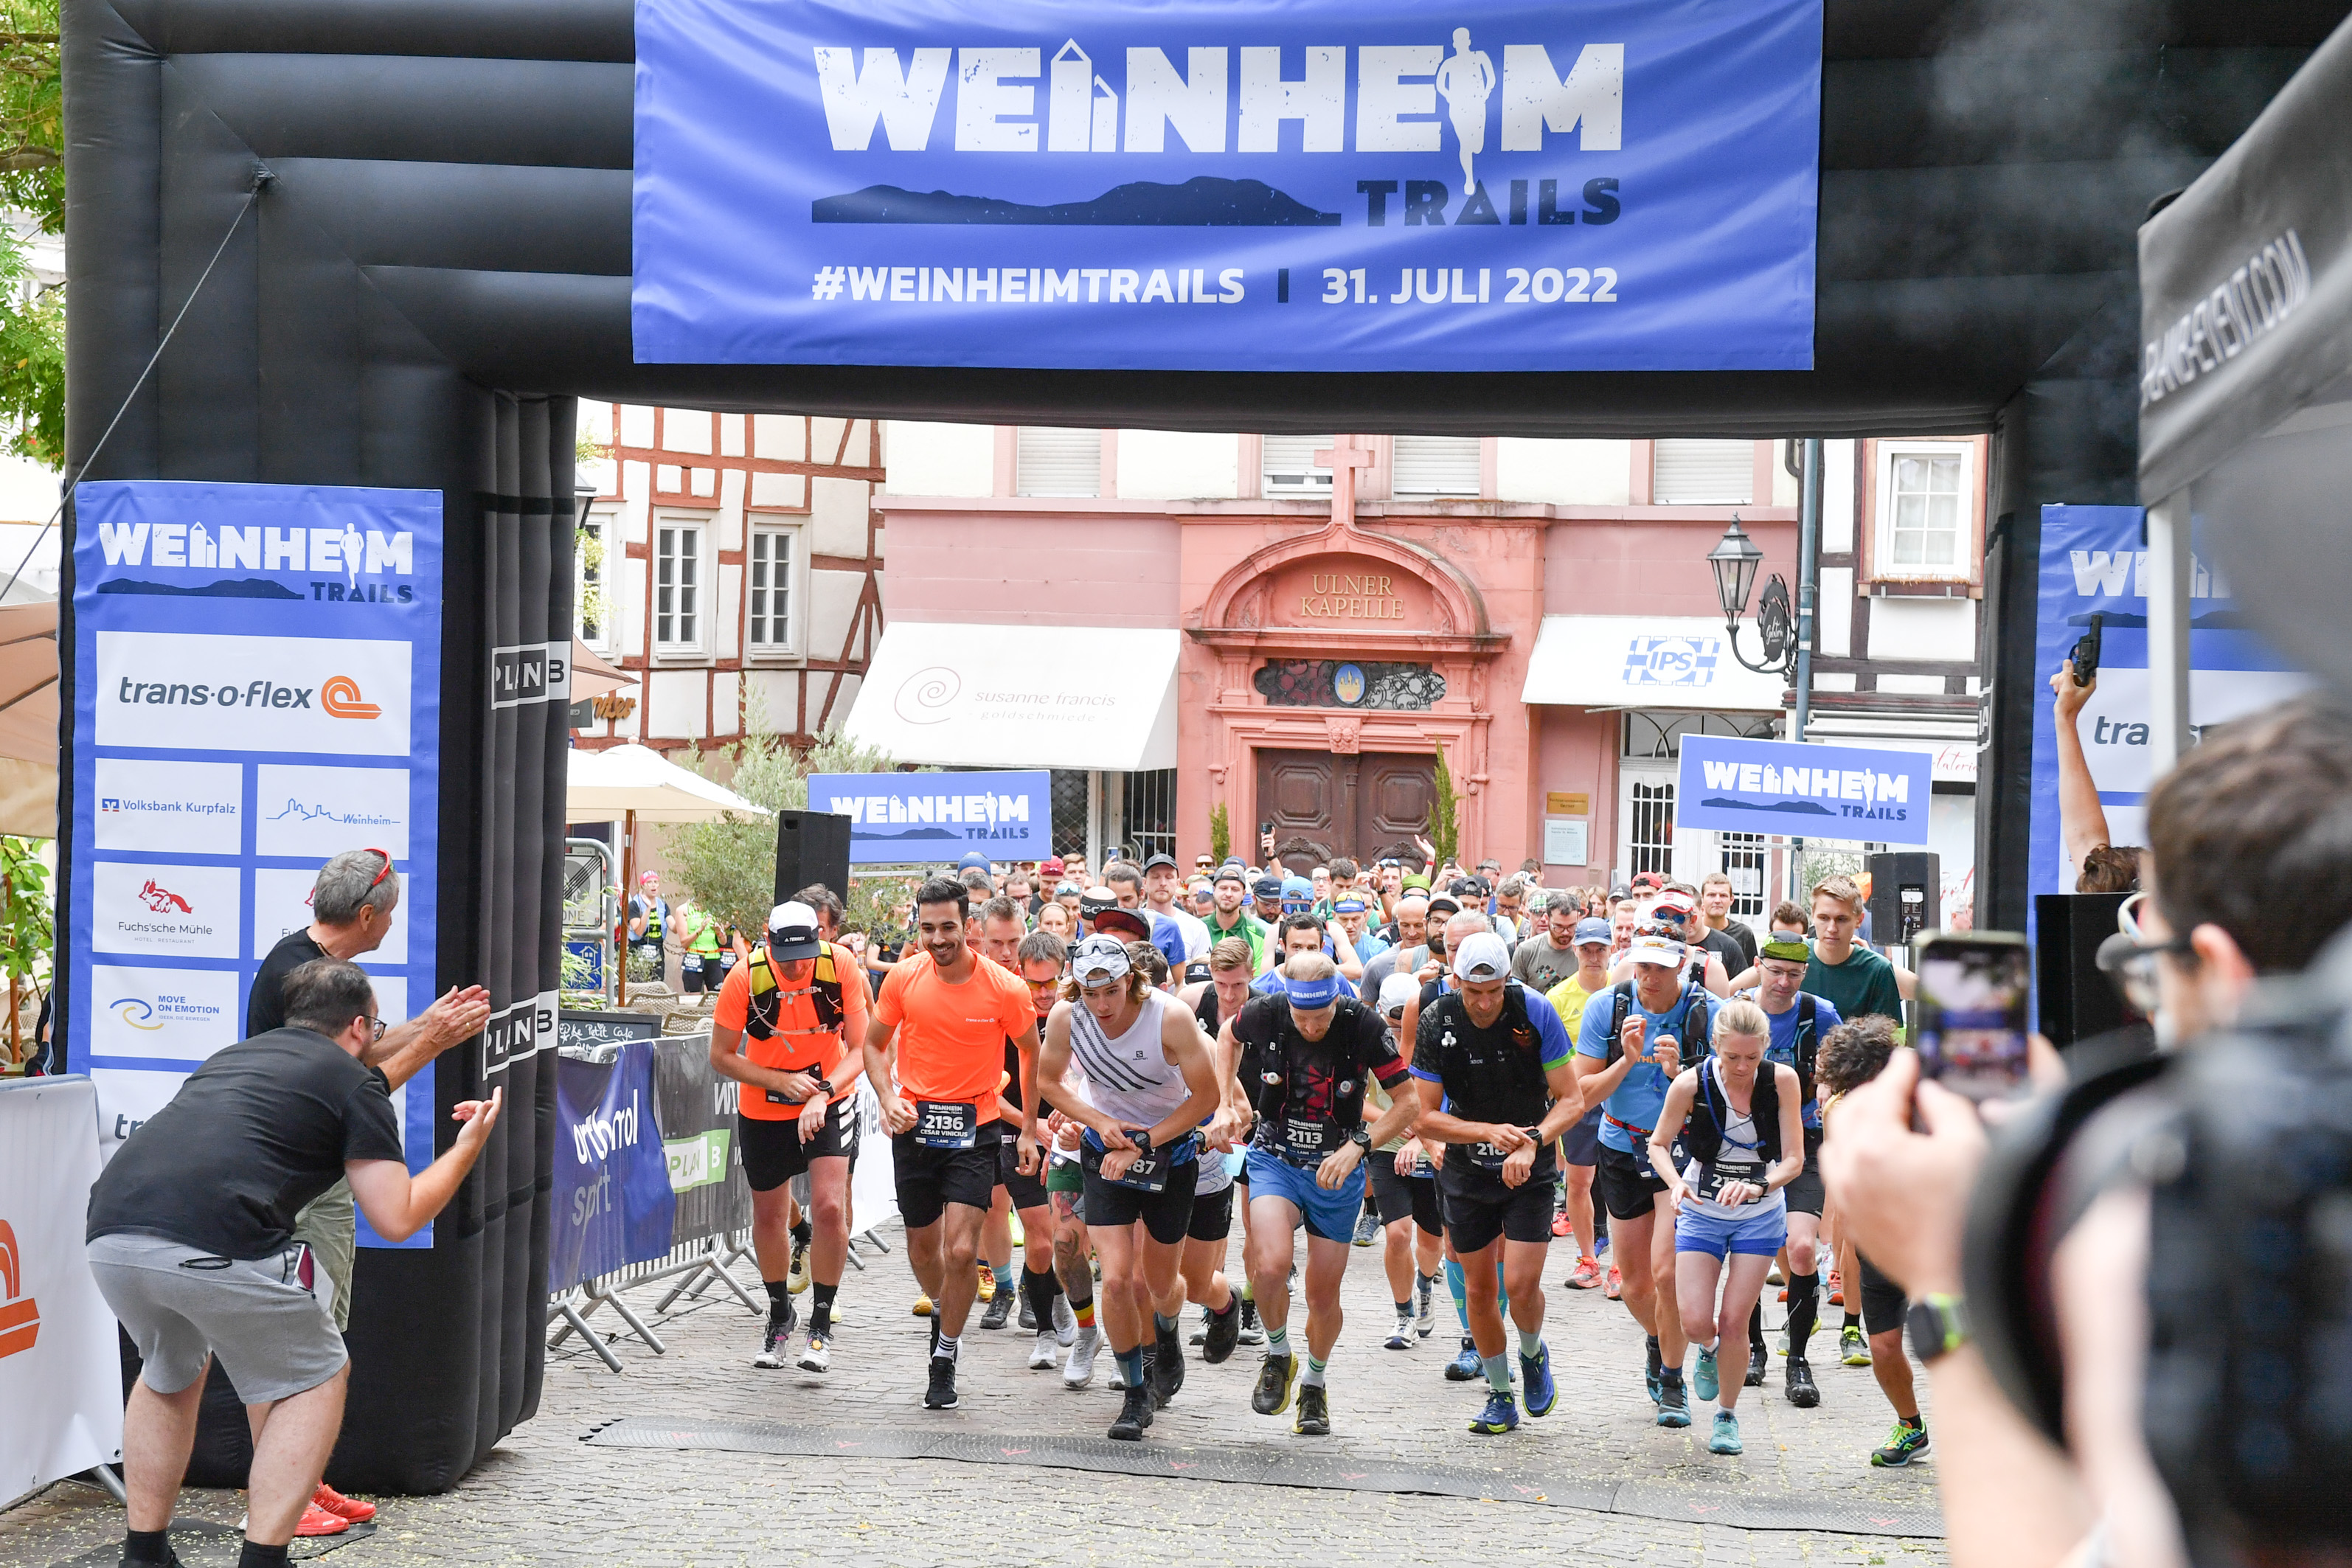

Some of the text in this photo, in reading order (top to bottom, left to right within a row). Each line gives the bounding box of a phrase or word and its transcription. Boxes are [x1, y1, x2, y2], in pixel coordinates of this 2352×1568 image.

[812, 33, 1625, 159] WEINHEIM
[1357, 177, 1621, 226] TRAILS
[812, 266, 1617, 304] #WEINHEIMTRAILS 31. JULI 2022
[99, 522, 413, 578] WEINHEIM
[311, 581, 413, 603] TRAILS
[1312, 575, 1393, 596] ULNER
[1300, 596, 1405, 619] KAPELLE
[1649, 651, 1693, 670] IPS
[975, 691, 1116, 707] susanne francis
[1703, 760, 1909, 804] WEINHEIM
[122, 799, 236, 815] Volksbank Kurpfalz
[830, 793, 1029, 825] WEINHEIM
[1841, 805, 1907, 822] TRAILS
[343, 814, 392, 825] Weinheim
[965, 828, 1029, 839] TRAILS
[562, 910, 585, 921] ONE
[119, 922, 212, 934] Fuchs'sche Mühle
[1291, 989, 1328, 999] WEINHEIM
[175, 1005, 219, 1013] EMOTION
[925, 1114, 965, 1130] 2136
[1286, 1128, 1323, 1145] 2113
[712, 1145, 721, 1169] B
[1126, 1159, 1156, 1175] 87
